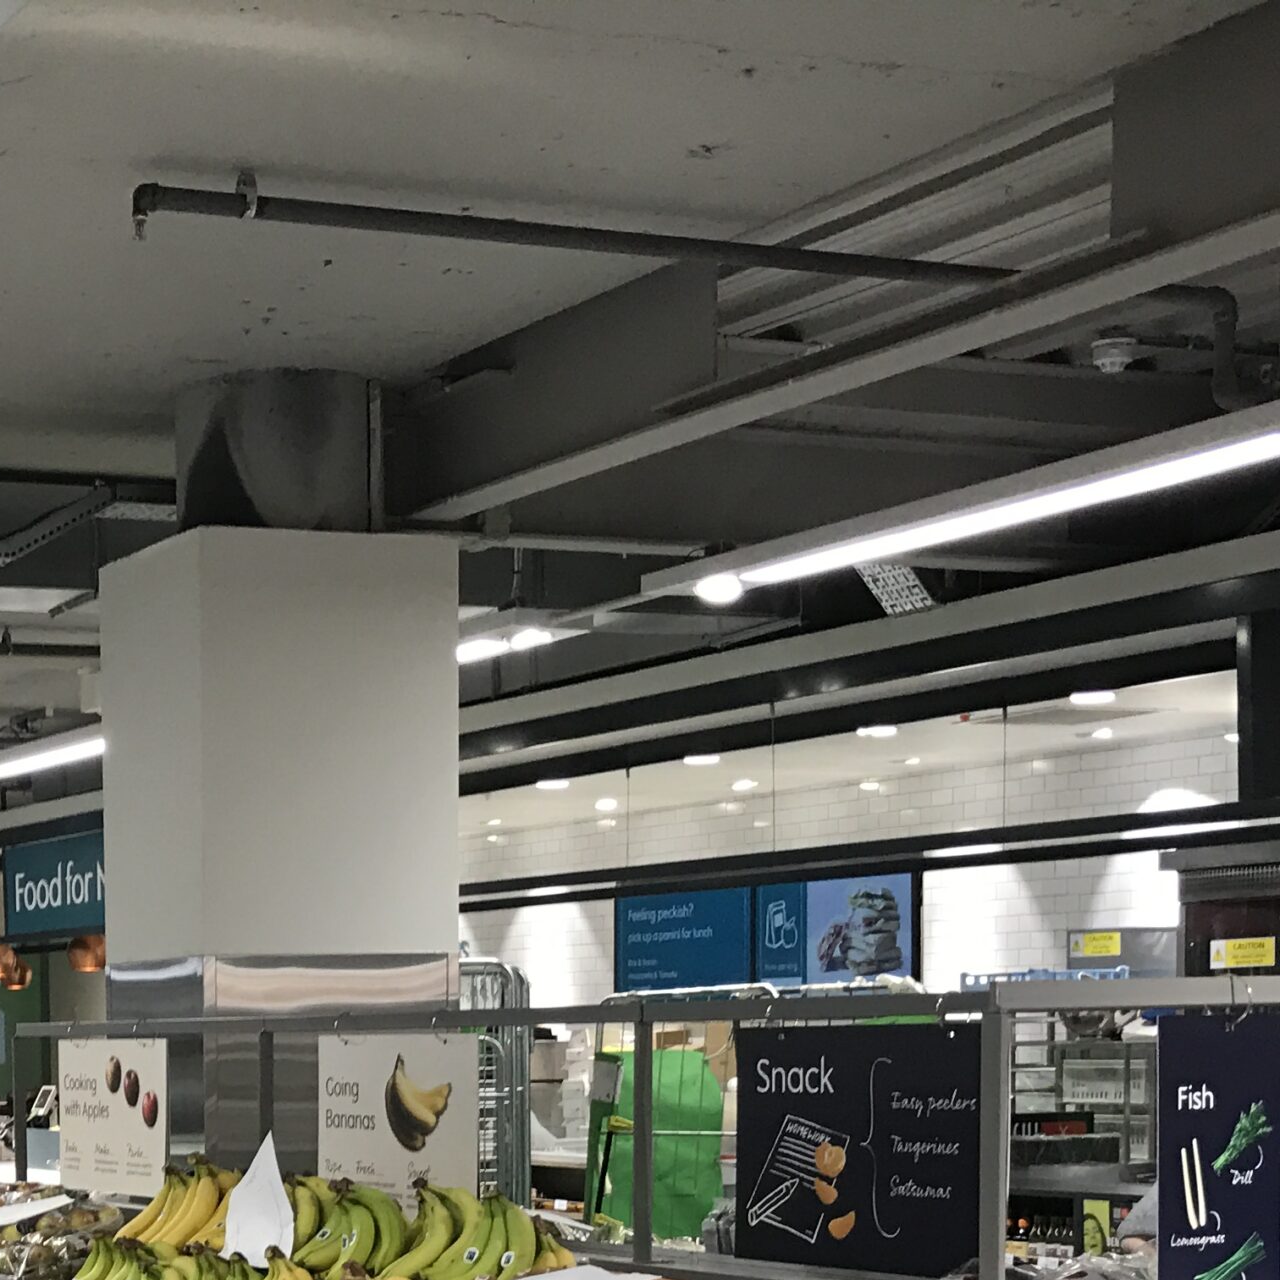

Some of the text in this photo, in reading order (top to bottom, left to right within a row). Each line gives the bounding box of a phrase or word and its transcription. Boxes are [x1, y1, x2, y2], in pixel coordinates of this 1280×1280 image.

[15, 861, 62, 912] Food
[65, 860, 93, 905] for
[628, 903, 694, 924] Feeling peckish?
[693, 926, 713, 938] lunch
[1233, 942, 1265, 950] CAUTION
[64, 1073, 97, 1096] Cooking
[756, 1056, 834, 1094] Snack
[325, 1077, 359, 1104] Going
[1177, 1084, 1214, 1110] Fish
[64, 1102, 109, 1122] with Apples
[890, 1089, 977, 1118] Easy peelers
[325, 1108, 376, 1131] Bananas
[785, 1121, 831, 1143] HOMEWORK
[890, 1134, 960, 1163] Tangerines
[889, 1175, 951, 1199] Satsumas
[1230, 1169, 1254, 1185] Dill
[1170, 1233, 1226, 1251] Lemongrass
